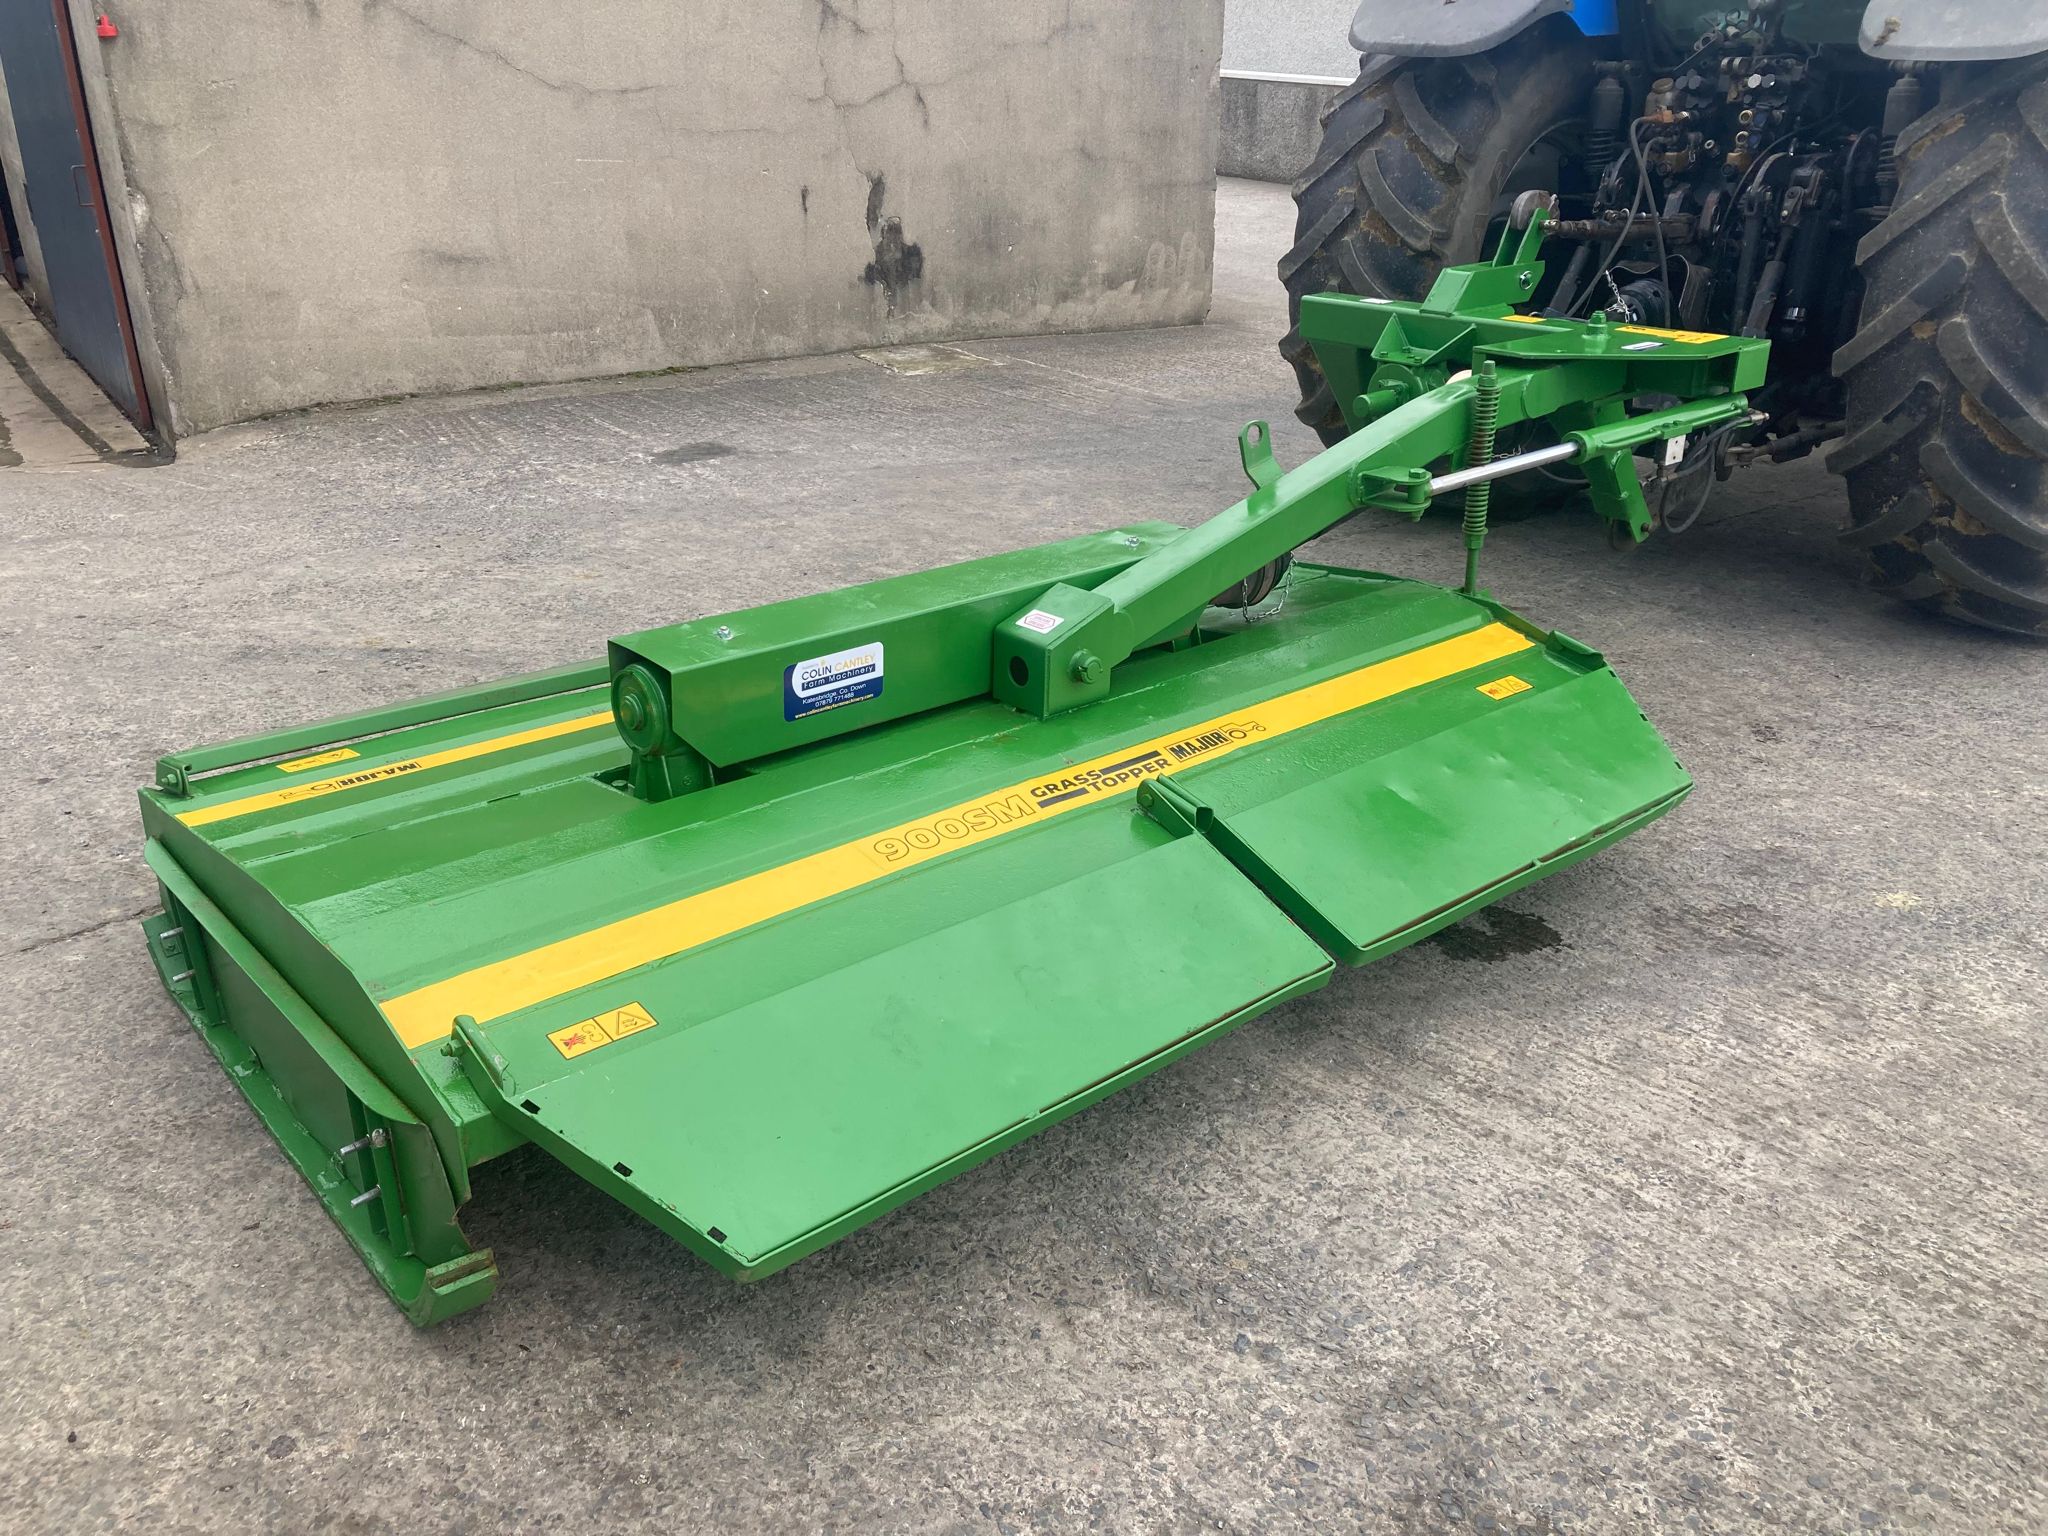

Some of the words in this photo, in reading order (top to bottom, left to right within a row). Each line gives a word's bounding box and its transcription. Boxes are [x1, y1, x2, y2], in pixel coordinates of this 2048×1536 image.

[802, 665, 832, 681] COLIN
[835, 654, 875, 672] CANTLEY
[804, 677, 825, 689] Farm
[829, 665, 873, 682] Machinery
[851, 682, 867, 692] Down
[1169, 730, 1229, 760] MAJOR
[340, 763, 418, 786] MAJOR
[1030, 770, 1102, 798] GRASS
[1086, 758, 1173, 792] TOPPER
[873, 794, 1037, 863] 900SM
